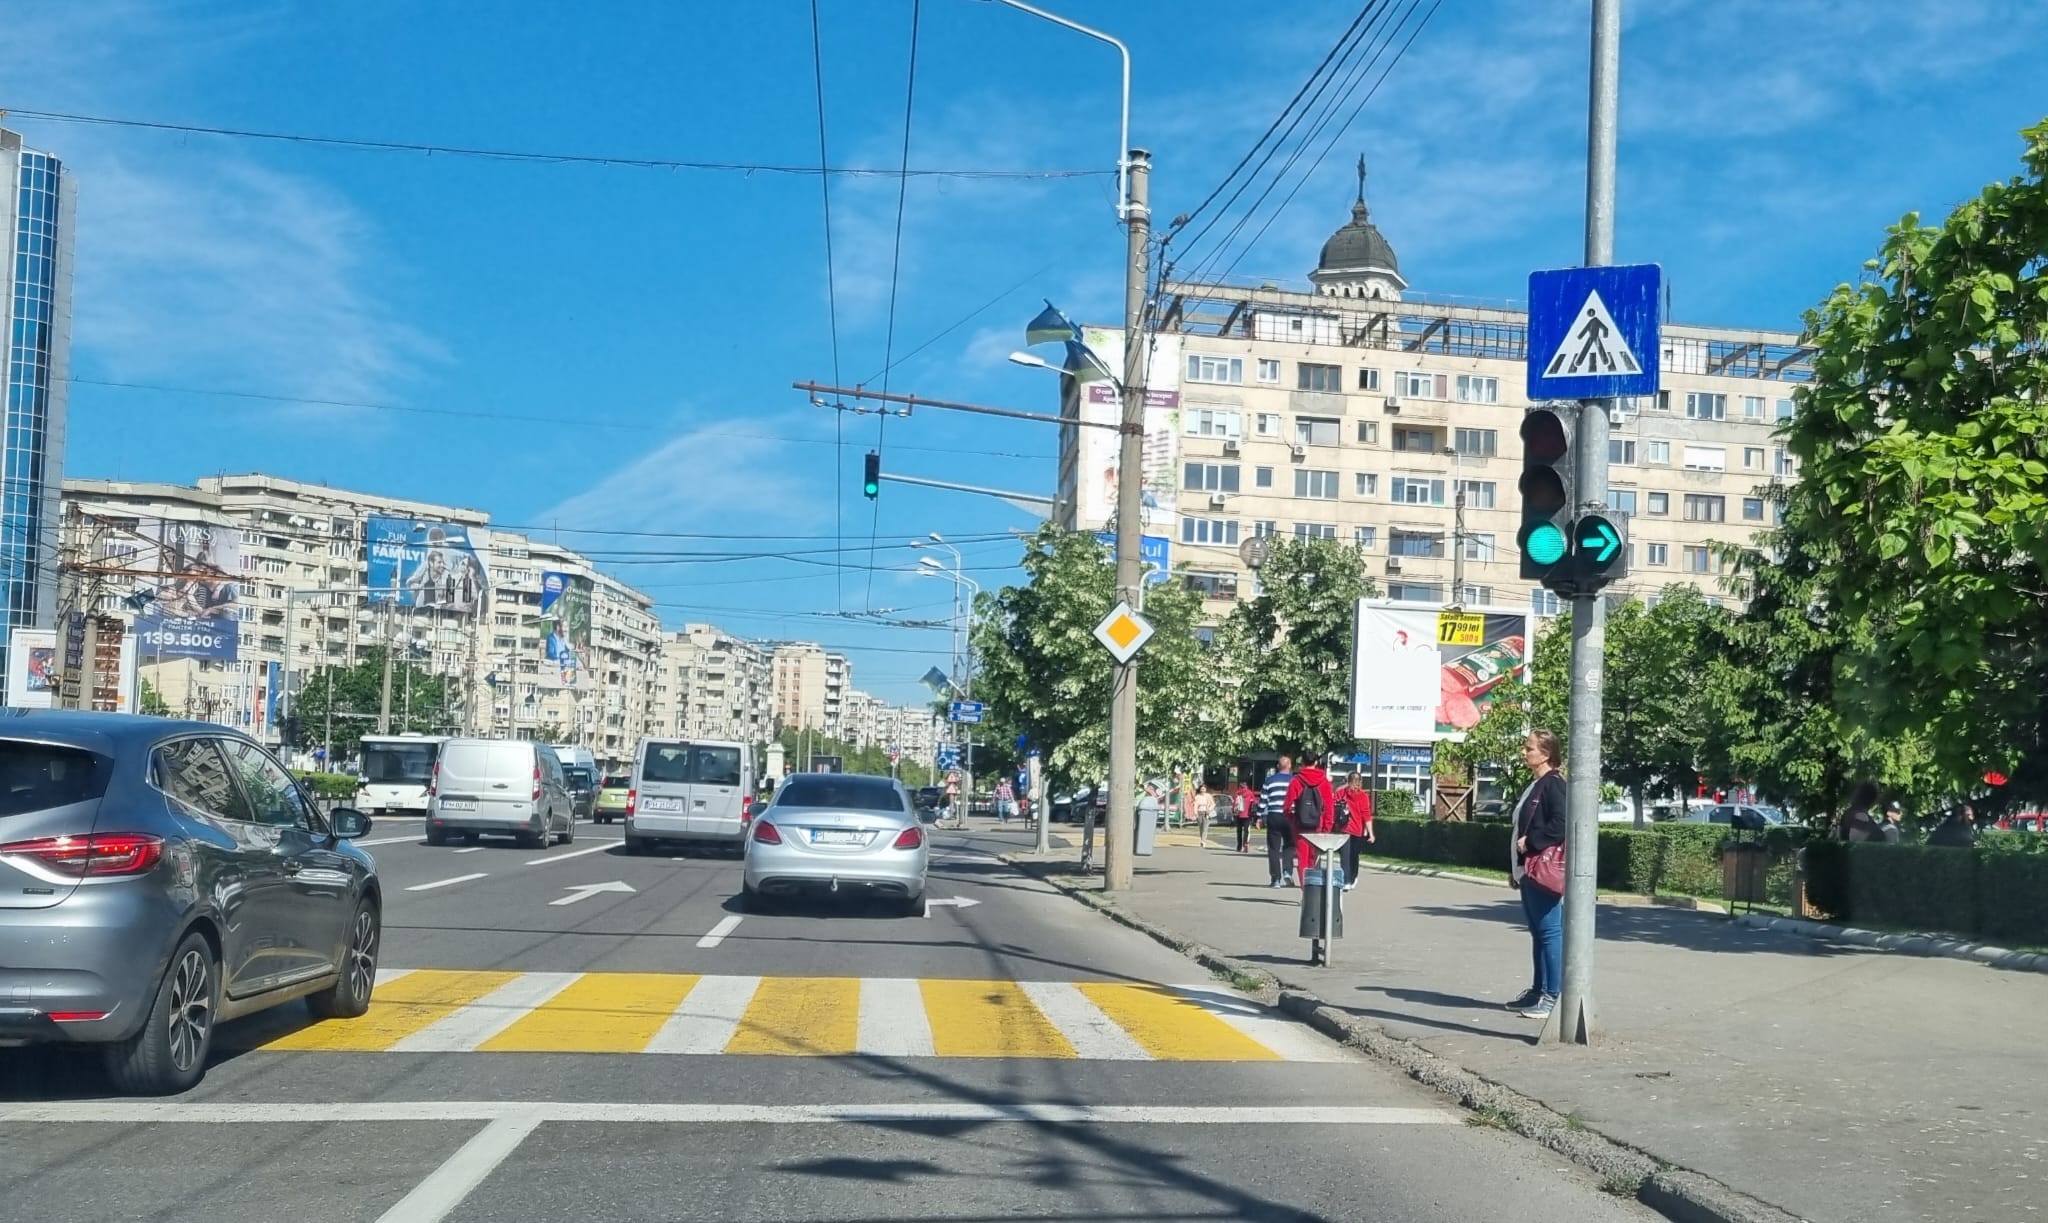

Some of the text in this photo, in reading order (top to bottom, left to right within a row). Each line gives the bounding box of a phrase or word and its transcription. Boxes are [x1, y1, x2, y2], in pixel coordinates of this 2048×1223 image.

[178, 526, 211, 540] MRS
[388, 531, 407, 541] FUN
[372, 545, 426, 563] FAMILY!
[143, 631, 222, 649] 139.500€
[1440, 621, 1457, 642] 17
[1457, 622, 1468, 632] 99
